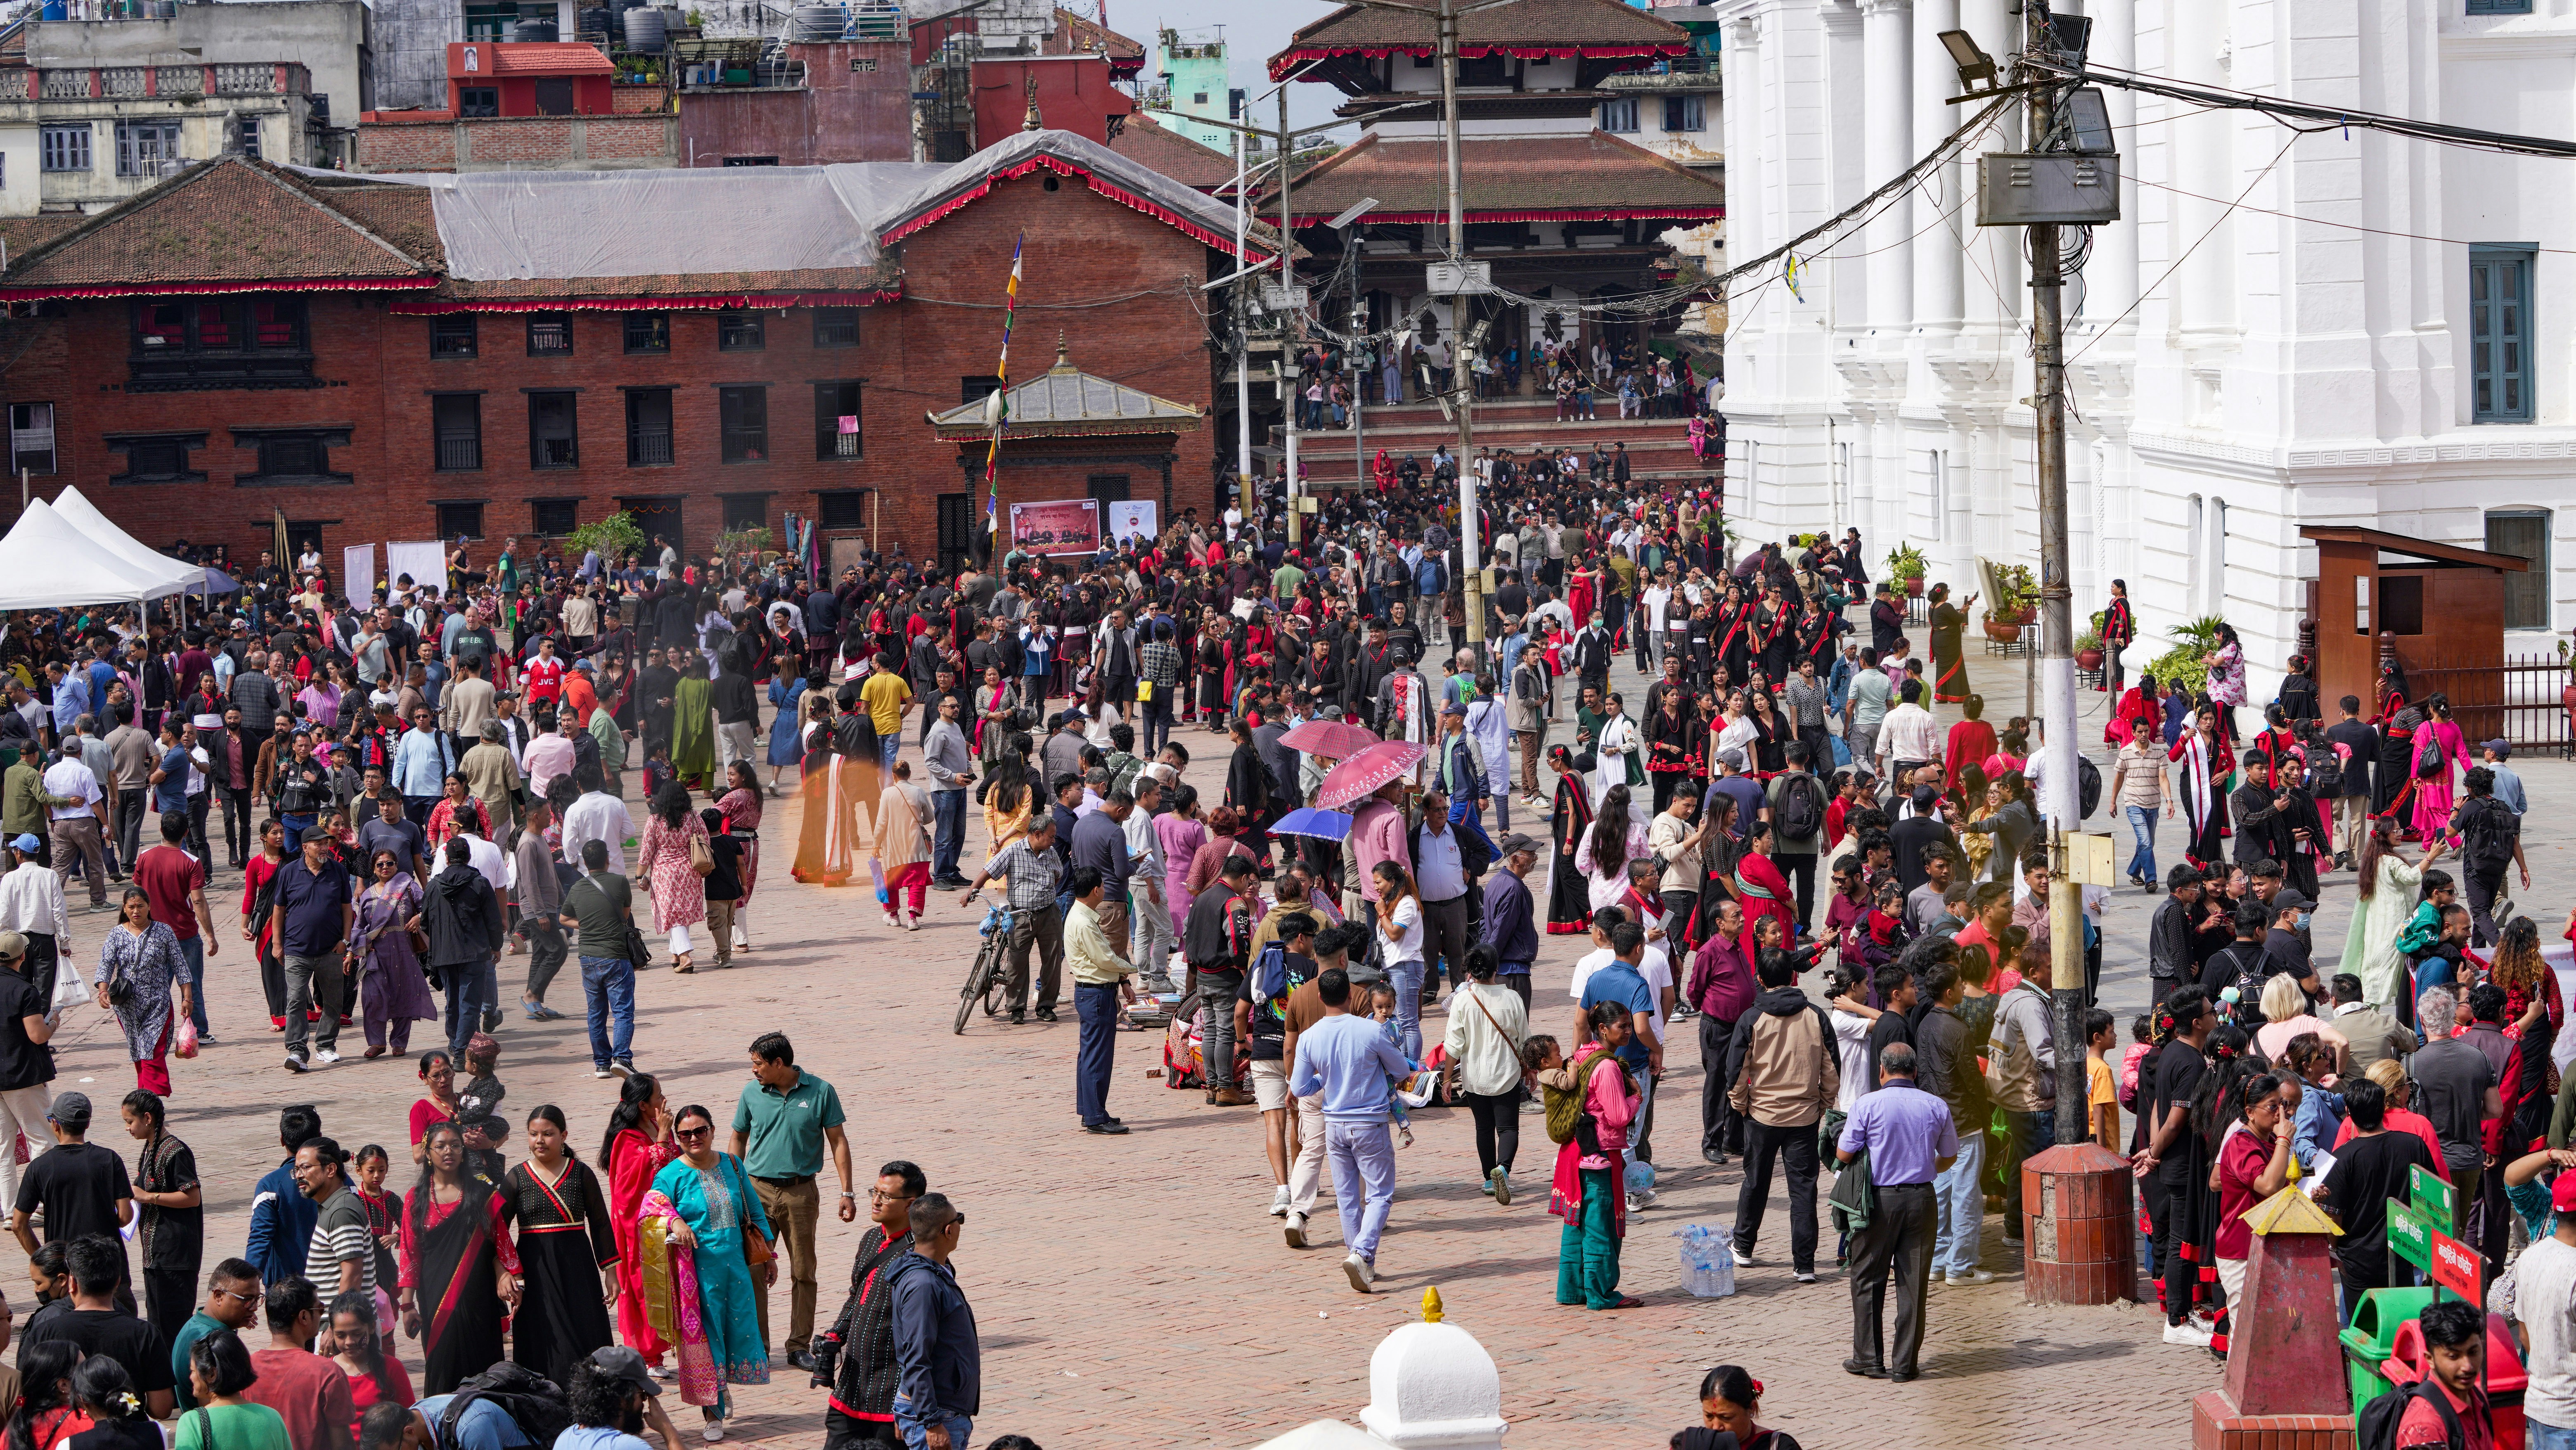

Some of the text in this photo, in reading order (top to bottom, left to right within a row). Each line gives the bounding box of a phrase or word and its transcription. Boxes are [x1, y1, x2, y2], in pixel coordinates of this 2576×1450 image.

[287, 779, 310, 788] Supreme
[1237, 915, 1249, 925] 38
[2395, 1214, 2423, 1244] कुहिने फोहोर
[2438, 1243, 2472, 1277] नकुहिने फोहोर
